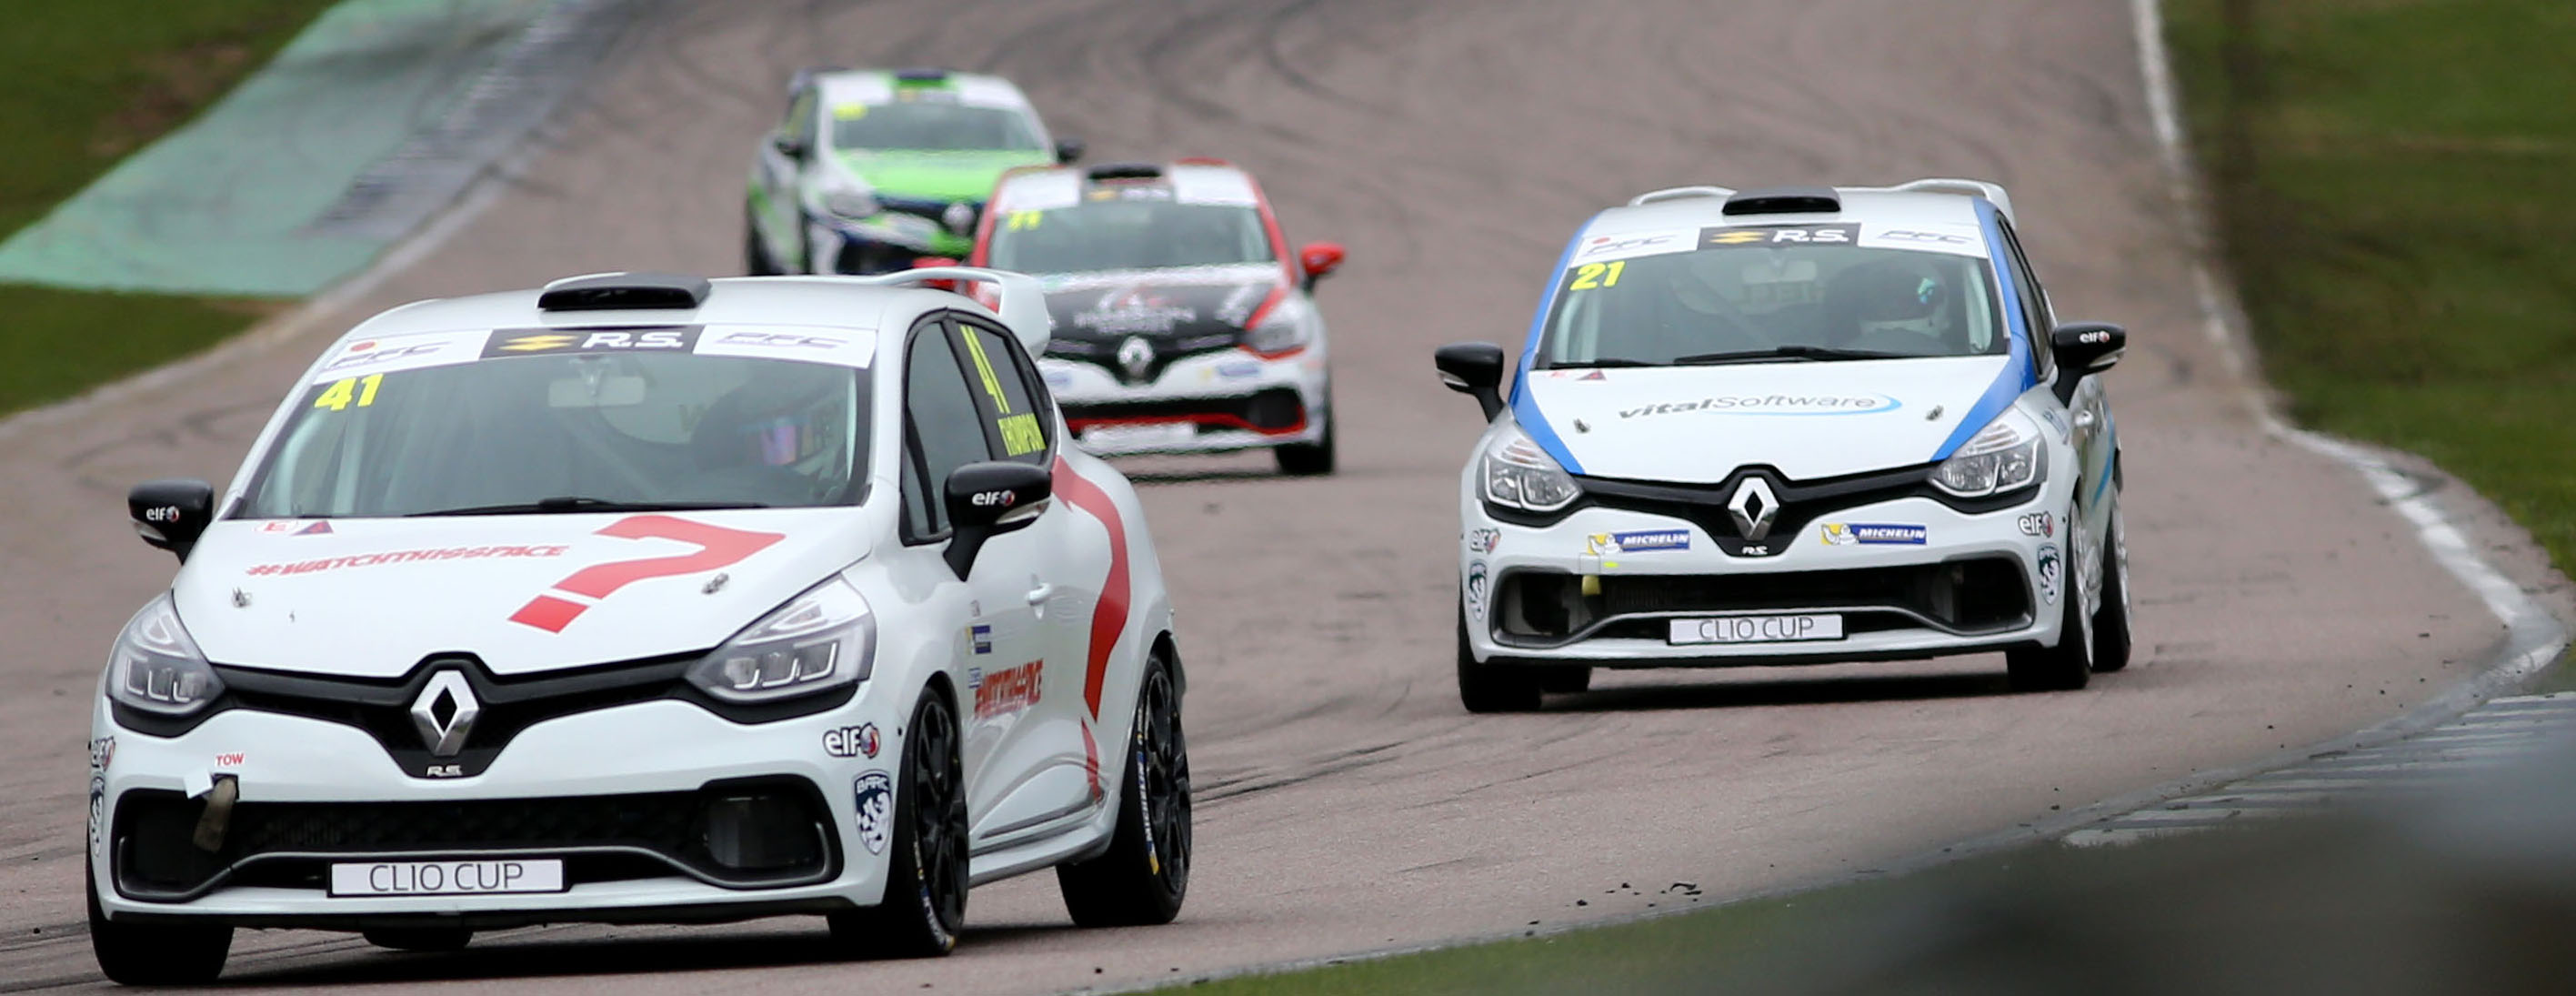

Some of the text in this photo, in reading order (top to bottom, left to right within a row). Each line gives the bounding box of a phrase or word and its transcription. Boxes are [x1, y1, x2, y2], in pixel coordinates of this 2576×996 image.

[1773, 229, 1849, 242] R.S.
[1569, 260, 1625, 291] 21
[582, 332, 682, 349] R.S.
[2079, 332, 2100, 344] elf
[314, 372, 383, 411] 41
[1619, 394, 1877, 419] vitalSoftware
[971, 492, 1001, 506] elf
[145, 507, 166, 521] elf
[1859, 528, 1926, 538] MICHELIN
[2019, 514, 2043, 536] elf
[1622, 532, 1690, 546] MICHELIN
[246, 545, 570, 576] #WATCHTHISSPACE
[1699, 617, 1815, 640] CLIO CUP
[823, 727, 861, 757] elf
[216, 753, 246, 766] TOW
[368, 862, 524, 892] CLIO CUP
